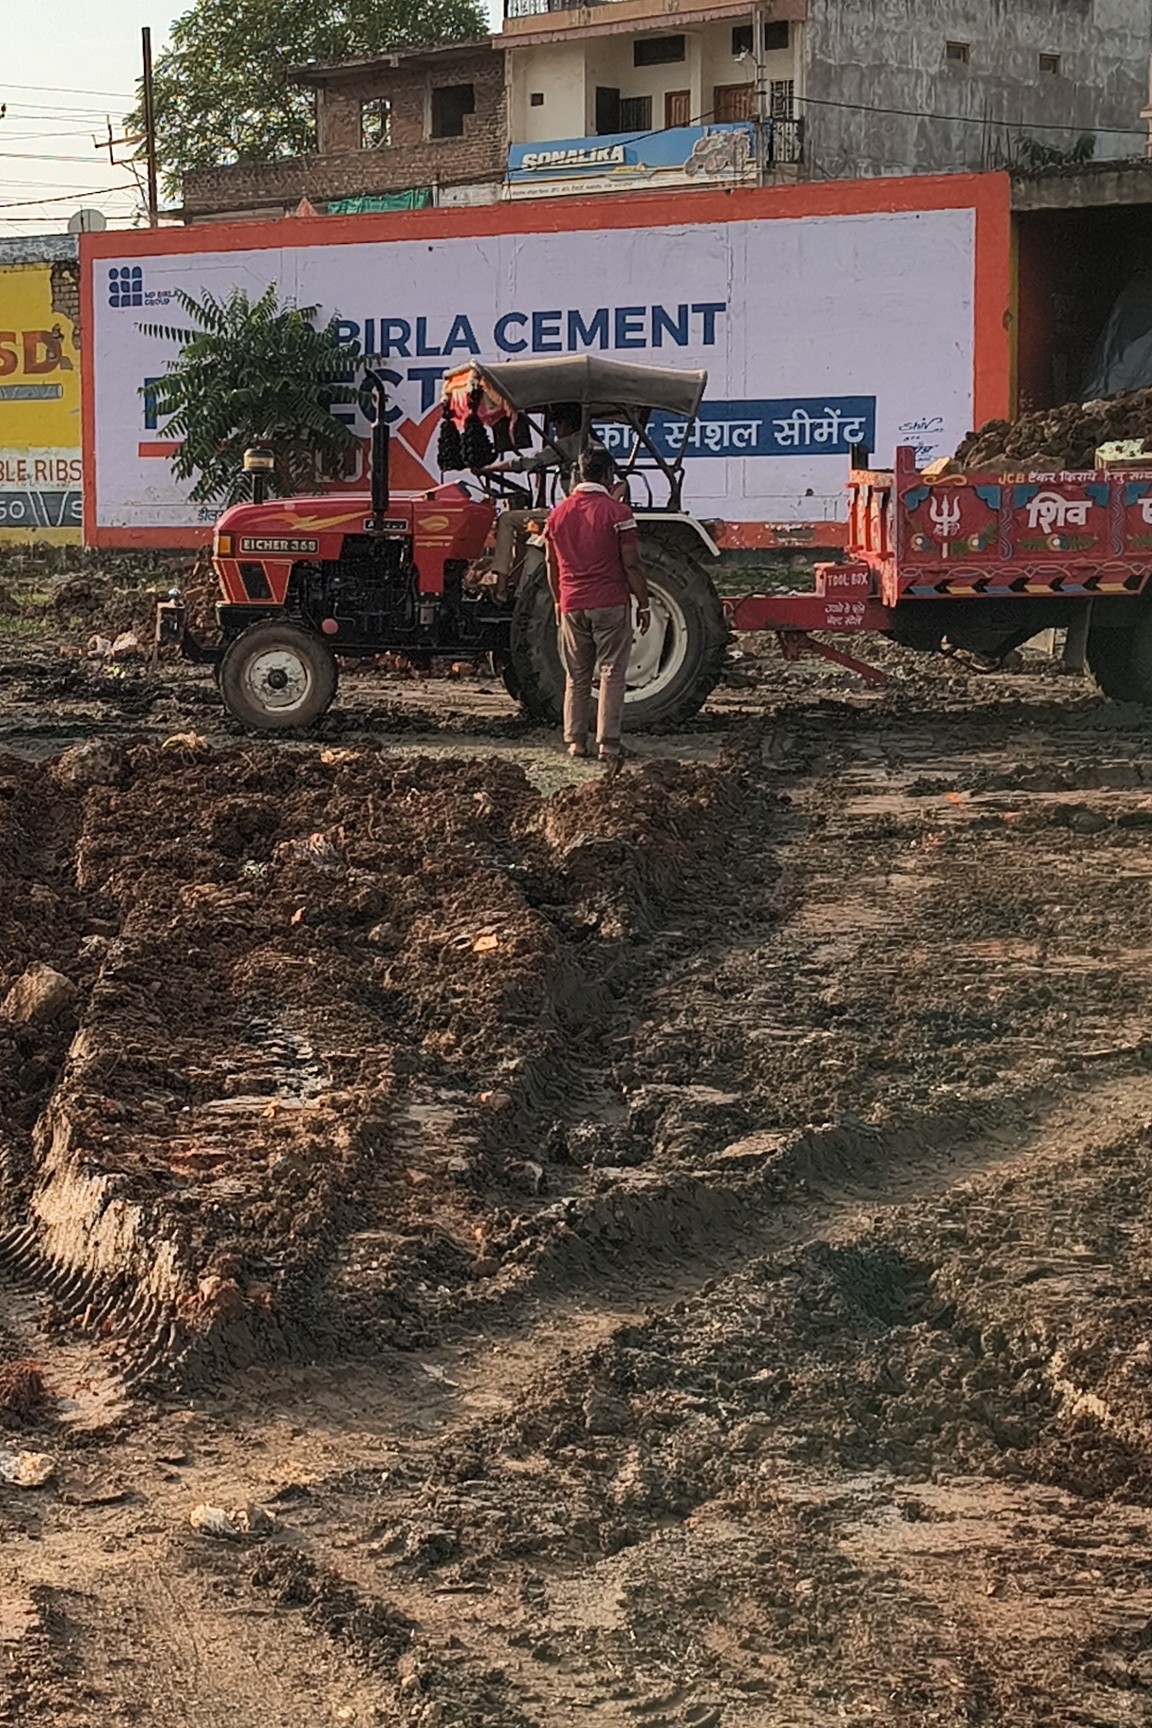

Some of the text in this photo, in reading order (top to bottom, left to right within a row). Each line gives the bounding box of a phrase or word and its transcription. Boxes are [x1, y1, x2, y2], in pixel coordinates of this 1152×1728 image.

[522, 145, 625, 171] SONALIKA
[494, 302, 726, 353] CEMENT
[773, 406, 866, 446] सीमेंट
[34, 458, 83, 483] RIBS
[998, 473, 1025, 485] JCB
[1026, 491, 1093, 534] शिव
[243, 538, 289, 551] EICHER
